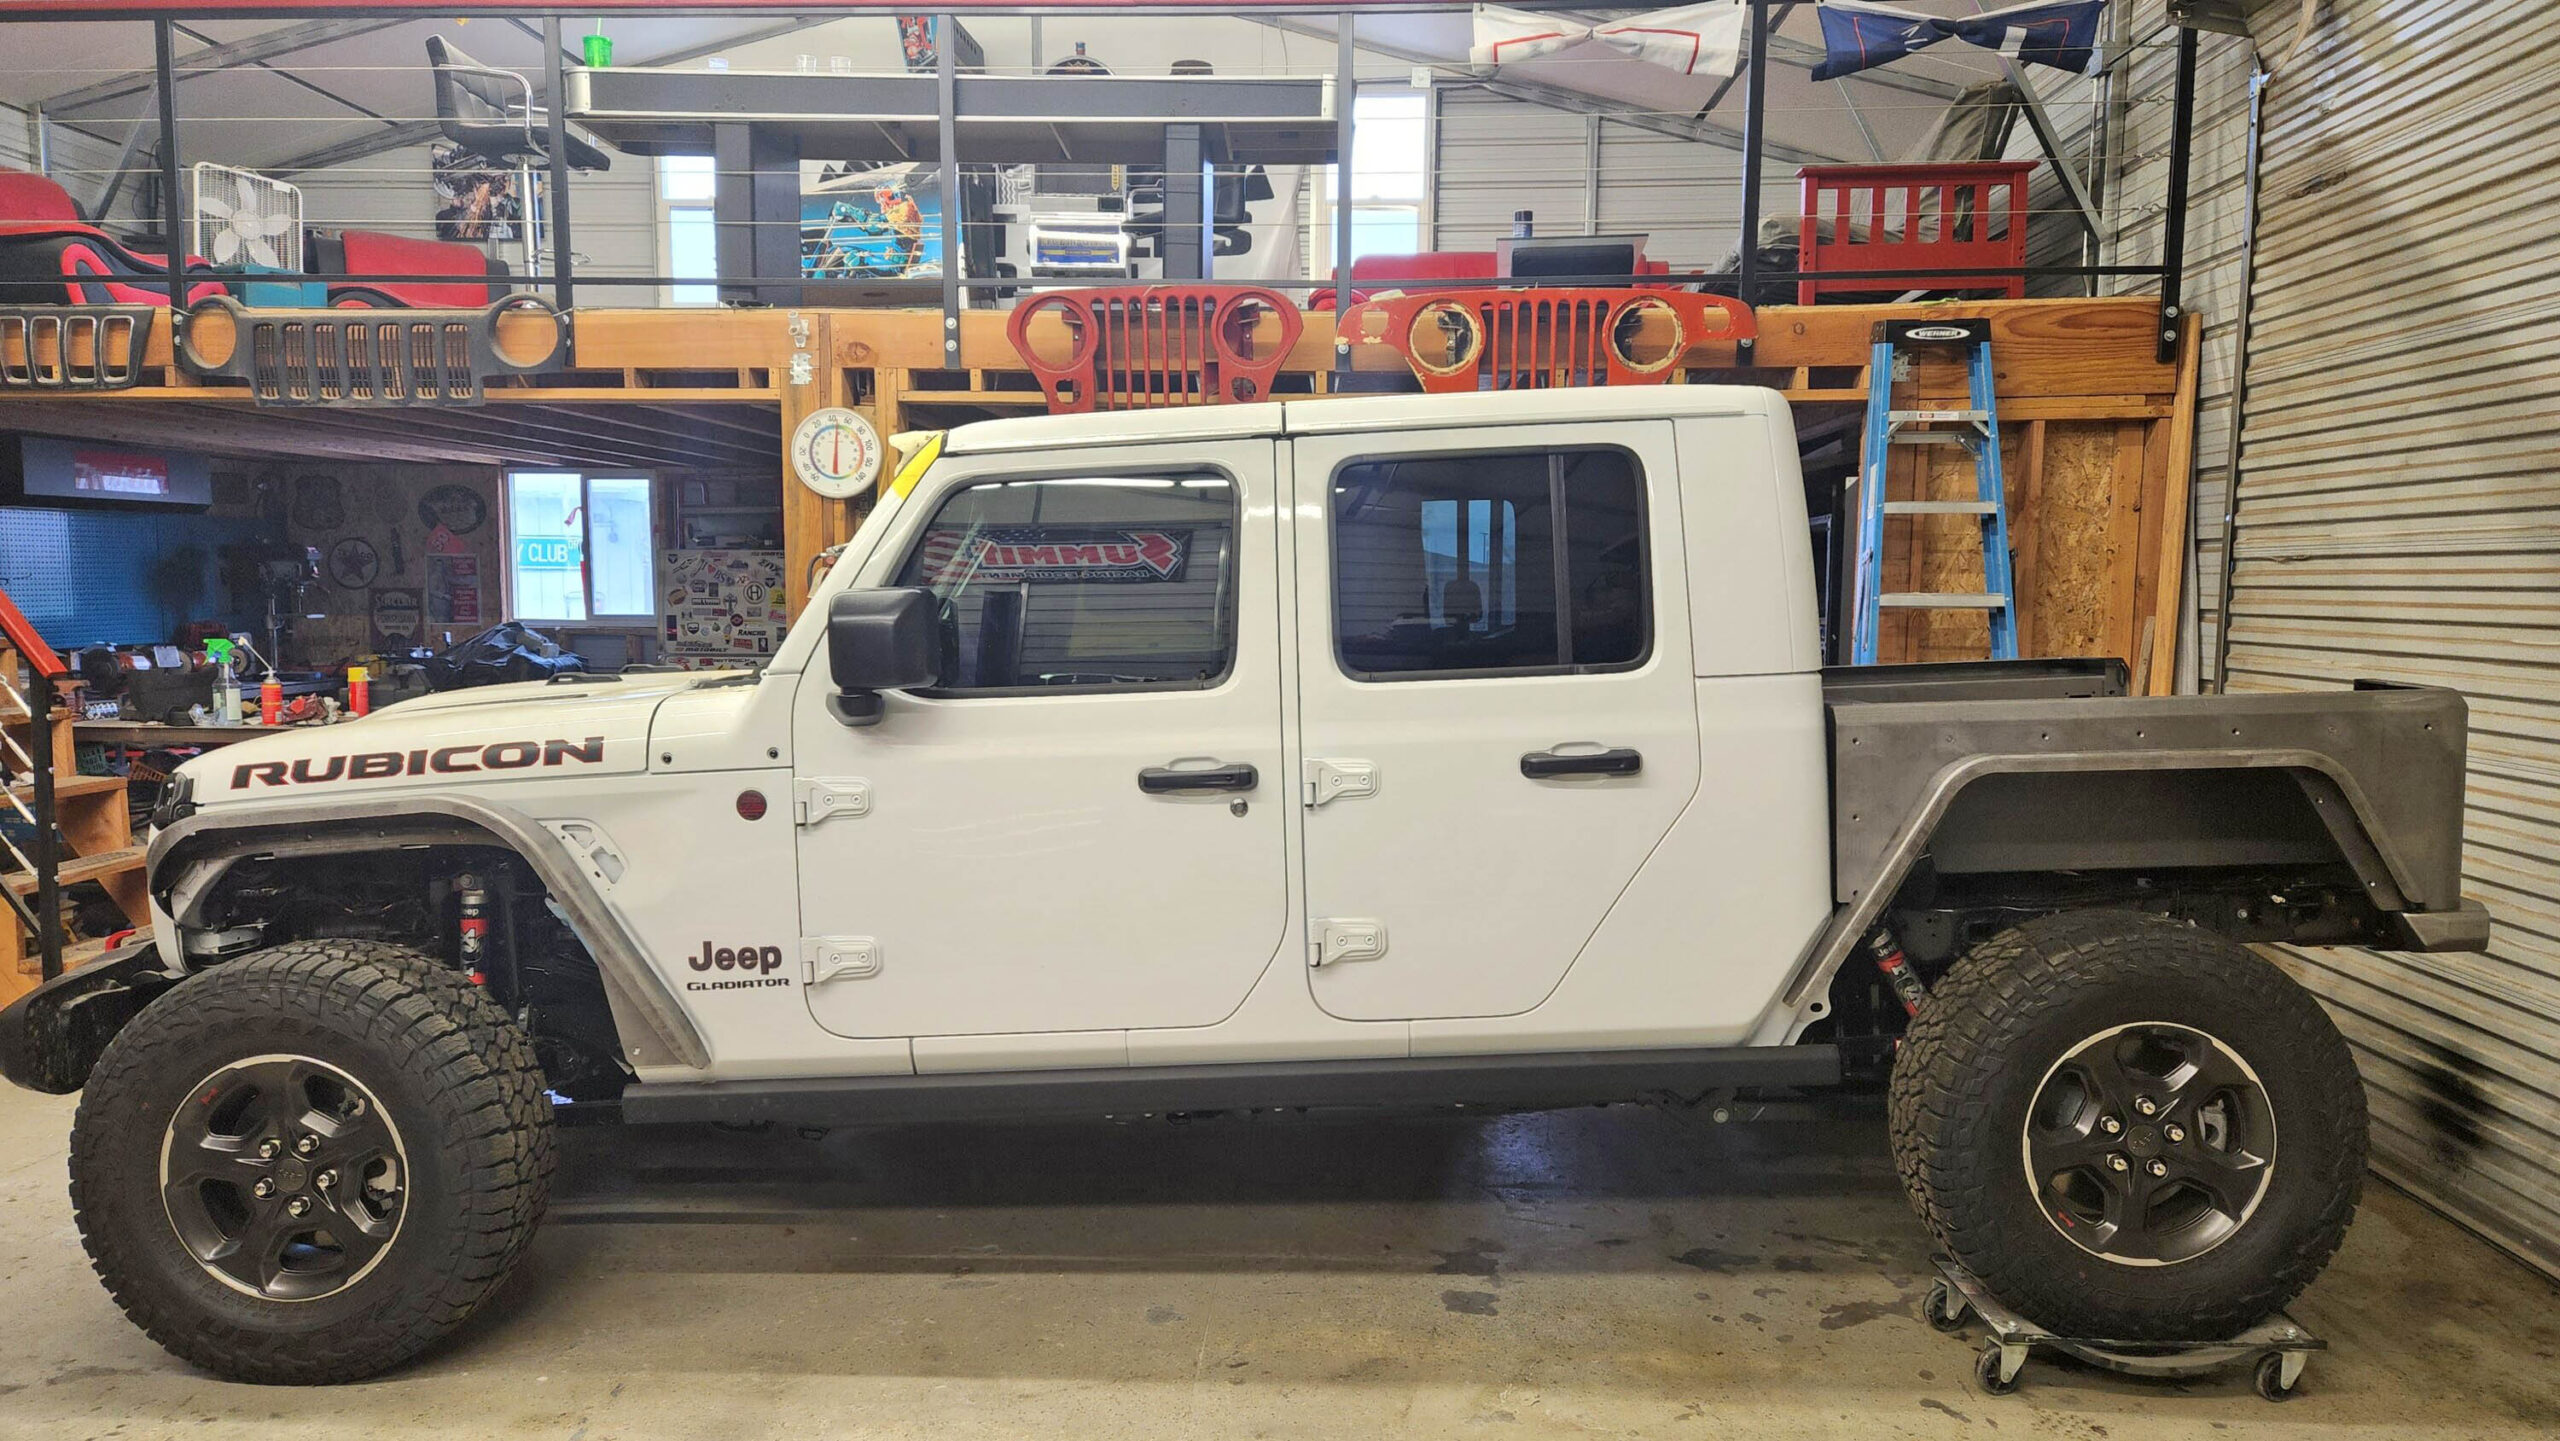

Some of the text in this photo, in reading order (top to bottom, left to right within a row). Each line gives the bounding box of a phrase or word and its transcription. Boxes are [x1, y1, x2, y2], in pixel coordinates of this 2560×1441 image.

[1918, 329, 1958, 337] WERNER
[528, 543, 568, 562] CLUB
[230, 736, 605, 790] RUBICON
[688, 941, 783, 975] Jeep
[686, 977, 790, 991] GLADIATOR
